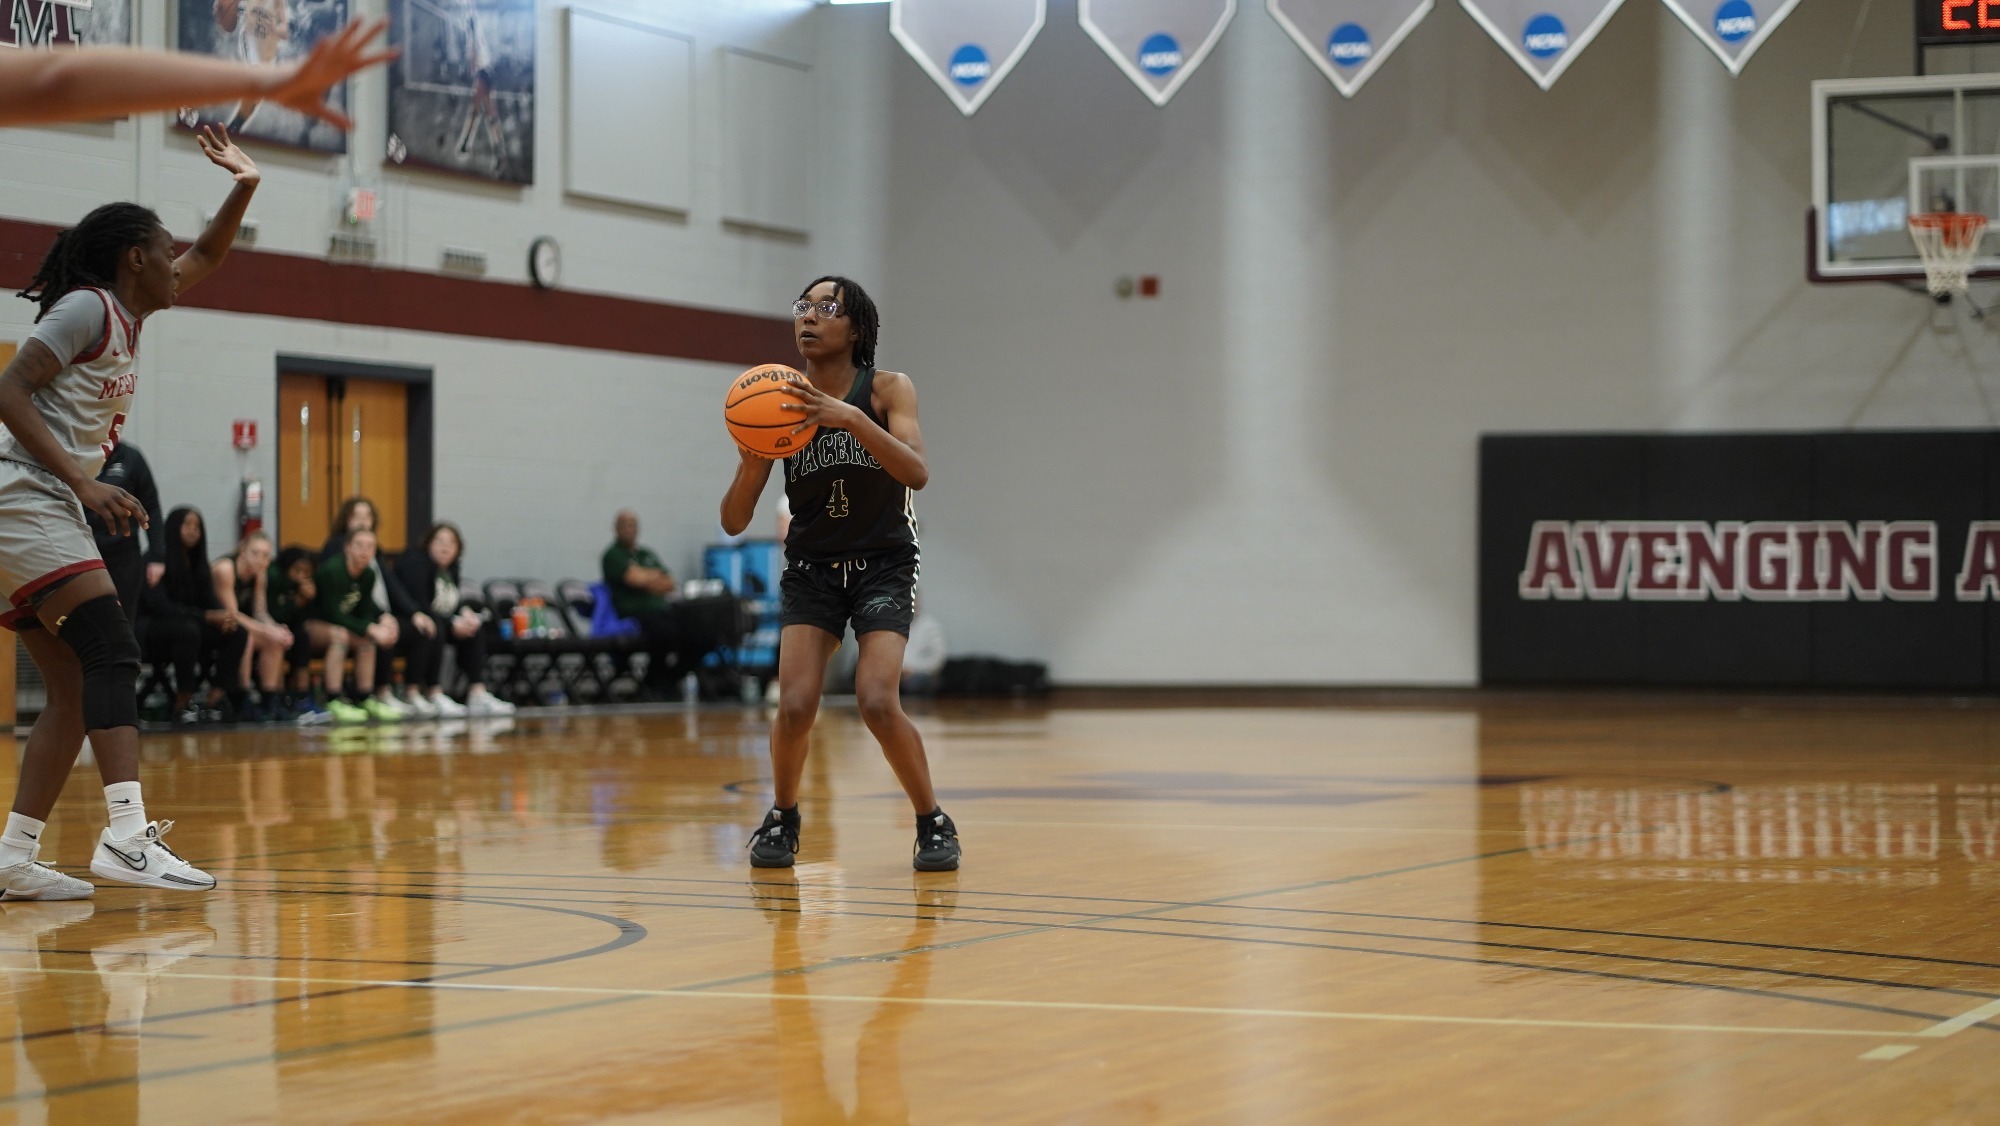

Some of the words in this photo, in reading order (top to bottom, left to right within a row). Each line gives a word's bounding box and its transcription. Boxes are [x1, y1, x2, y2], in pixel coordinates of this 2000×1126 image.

[740, 370, 804, 390] Wilson
[826, 479, 849, 518] 4
[1518, 520, 1937, 600] AVENGING
